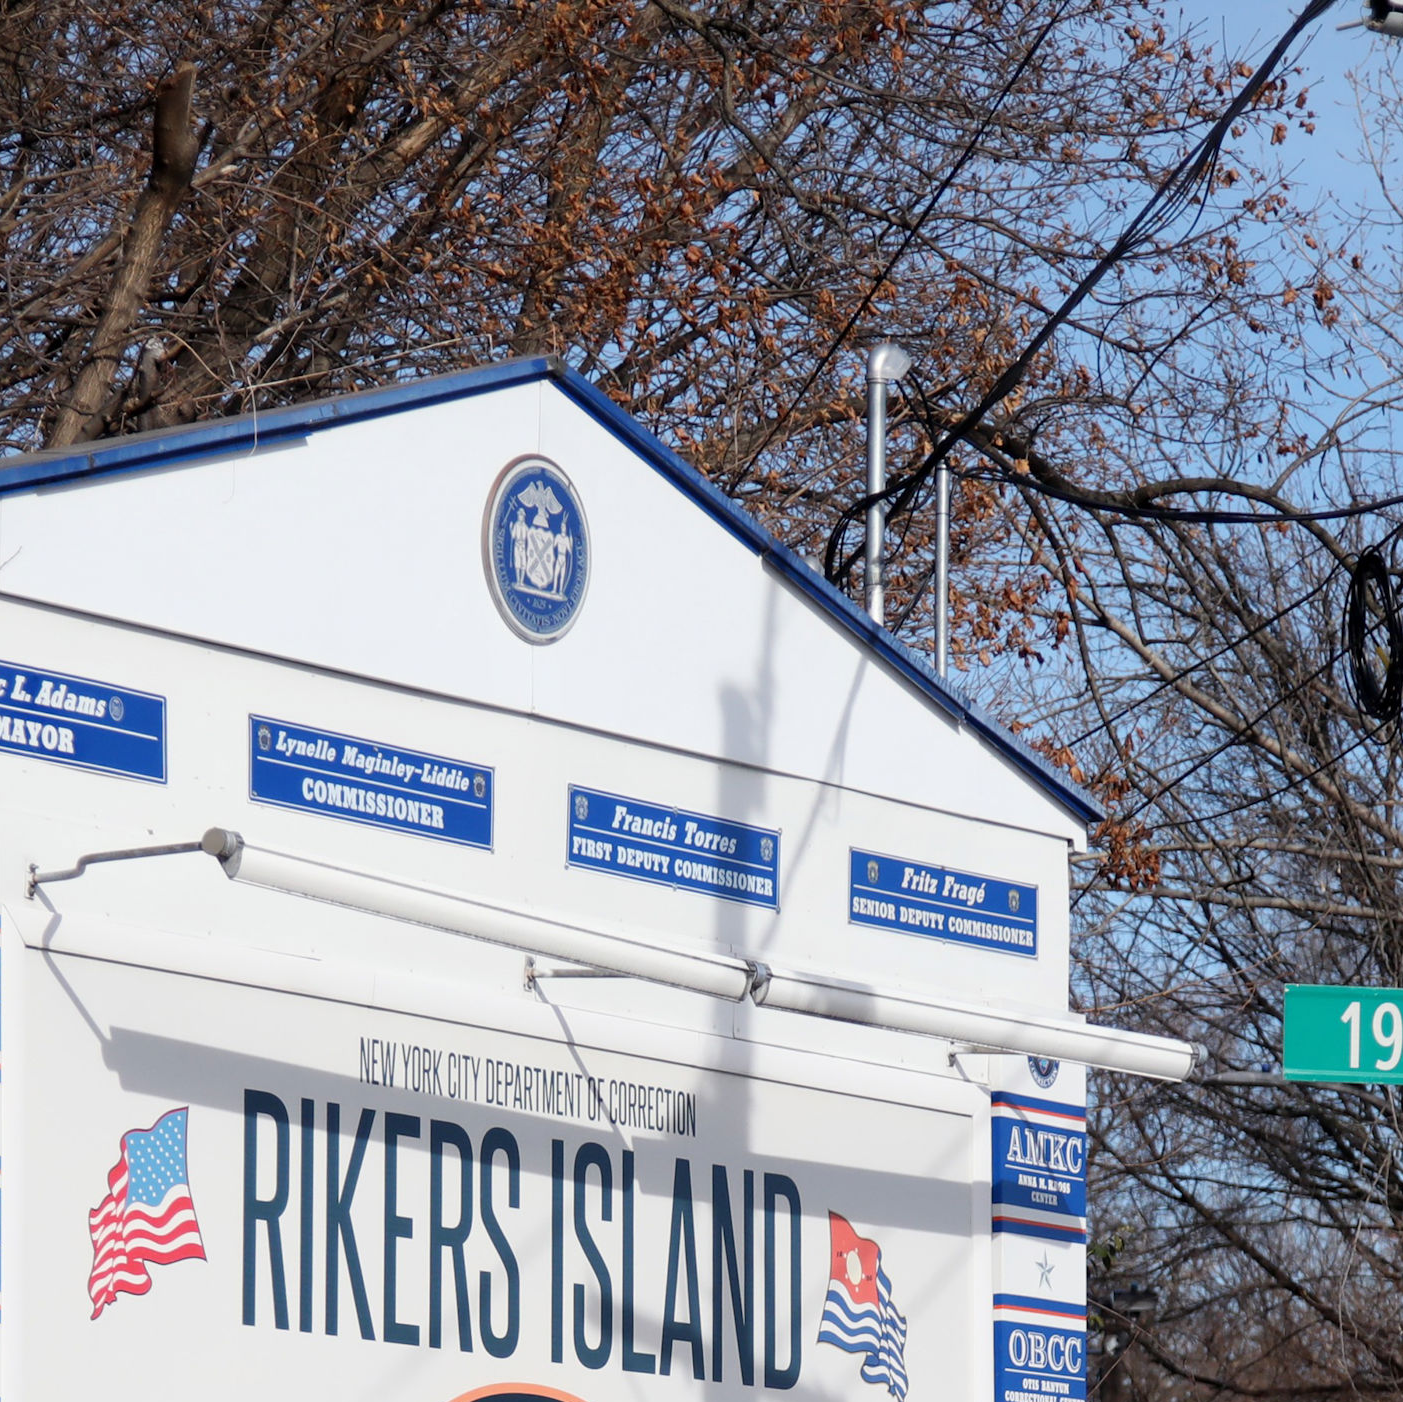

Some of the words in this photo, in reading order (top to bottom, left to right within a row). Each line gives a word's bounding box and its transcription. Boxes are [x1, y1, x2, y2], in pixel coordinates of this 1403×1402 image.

[10, 674, 32, 703] L.
[34, 679, 107, 718] Adams
[275, 730, 337, 762] Lynelle
[341, 745, 470, 792] Maginley-Liddie
[301, 776, 445, 830] COMMISSIONER
[611, 804, 678, 842] Francis
[684, 820, 738, 855] Torres
[572, 835, 613, 861] FIRST
[616, 845, 671, 875] DEPUTY
[674, 858, 774, 897] COMMISSIONER
[901, 866, 939, 895] Fritz
[942, 874, 987, 907] Fragé
[852, 895, 897, 921] SENIOR
[899, 905, 946, 931] DEPUTY
[948, 915, 1034, 948] COMMISSIONER
[1340, 1001, 1403, 1071] 19
[360, 1036, 397, 1088] NEW
[401, 1043, 443, 1097] YORK
[448, 1052, 482, 1103] CITY
[486, 1058, 583, 1119] DEPARTMENT
[587, 1076, 605, 1122] OF
[609, 1079, 697, 1138] CORRECTION
[1006, 1125, 1083, 1174] AMKC
[1018, 1173, 1037, 1188] ANNA
[1031, 1190, 1058, 1206] CENTER
[241, 1088, 521, 1360] RIKERS
[550, 1138, 803, 1391] ISLAND
[1008, 1328, 1082, 1374] OBCC
[1022, 1378, 1040, 1391] OTIS
